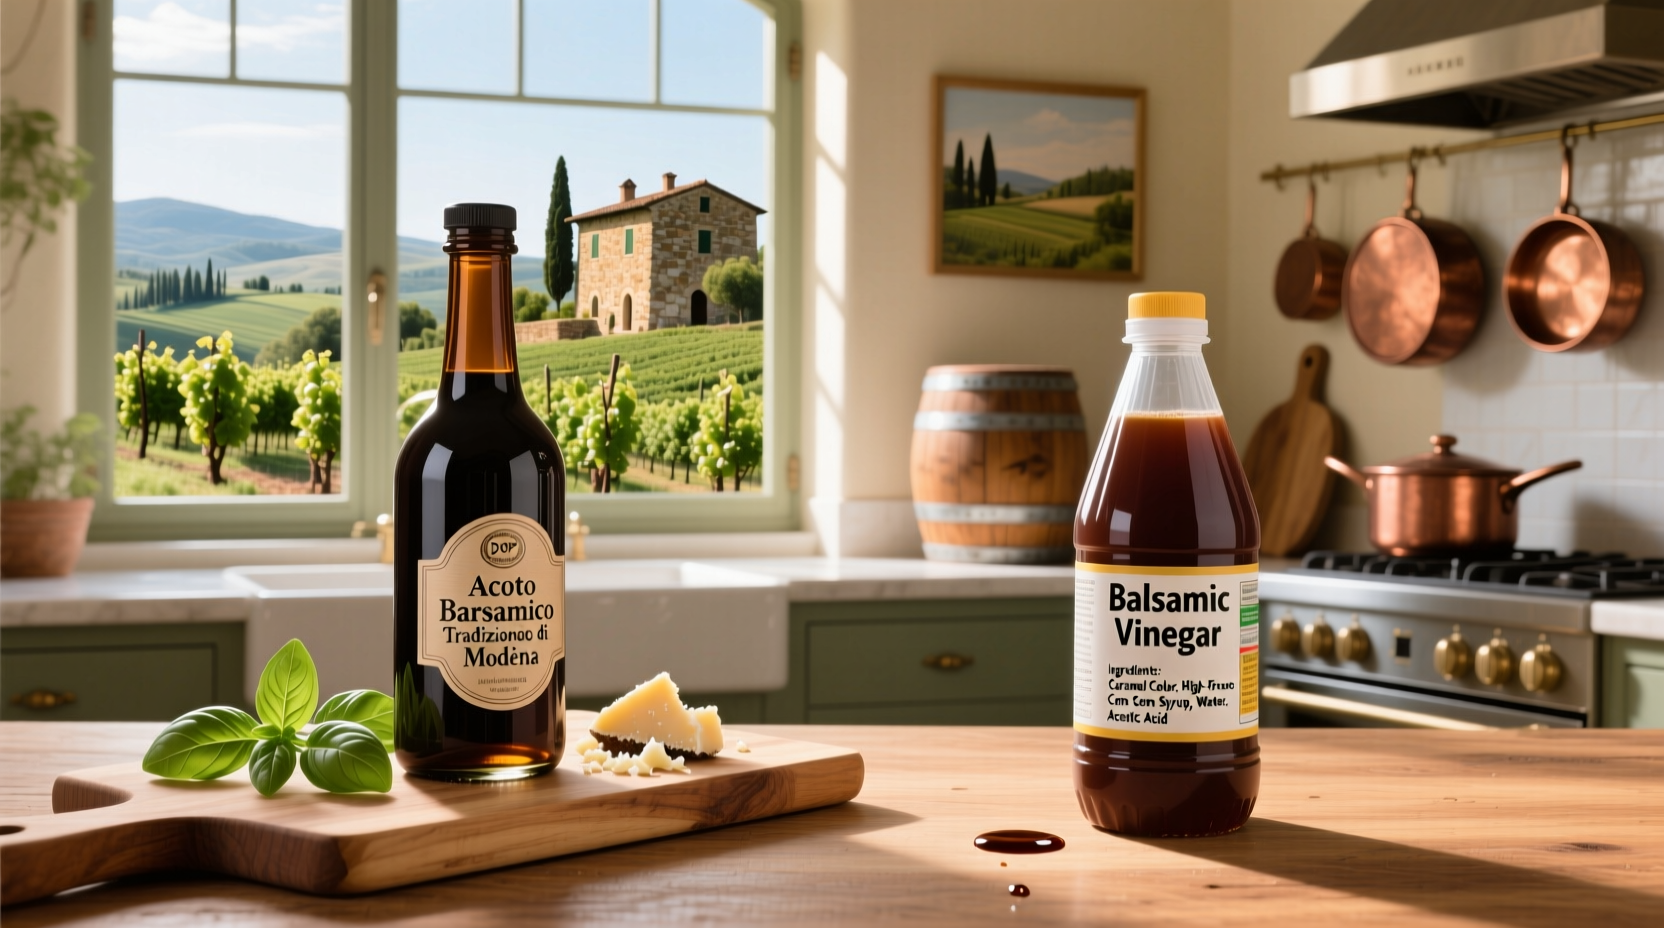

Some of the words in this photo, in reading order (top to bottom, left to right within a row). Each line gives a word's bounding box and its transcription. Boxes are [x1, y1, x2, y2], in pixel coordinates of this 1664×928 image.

[468, 575, 536, 597] Acoto
[1109, 583, 1230, 612] Balsamic
[439, 599, 554, 622] Barsamico
[537, 624, 548, 640] di
[1114, 617, 1221, 656] Vinegar
